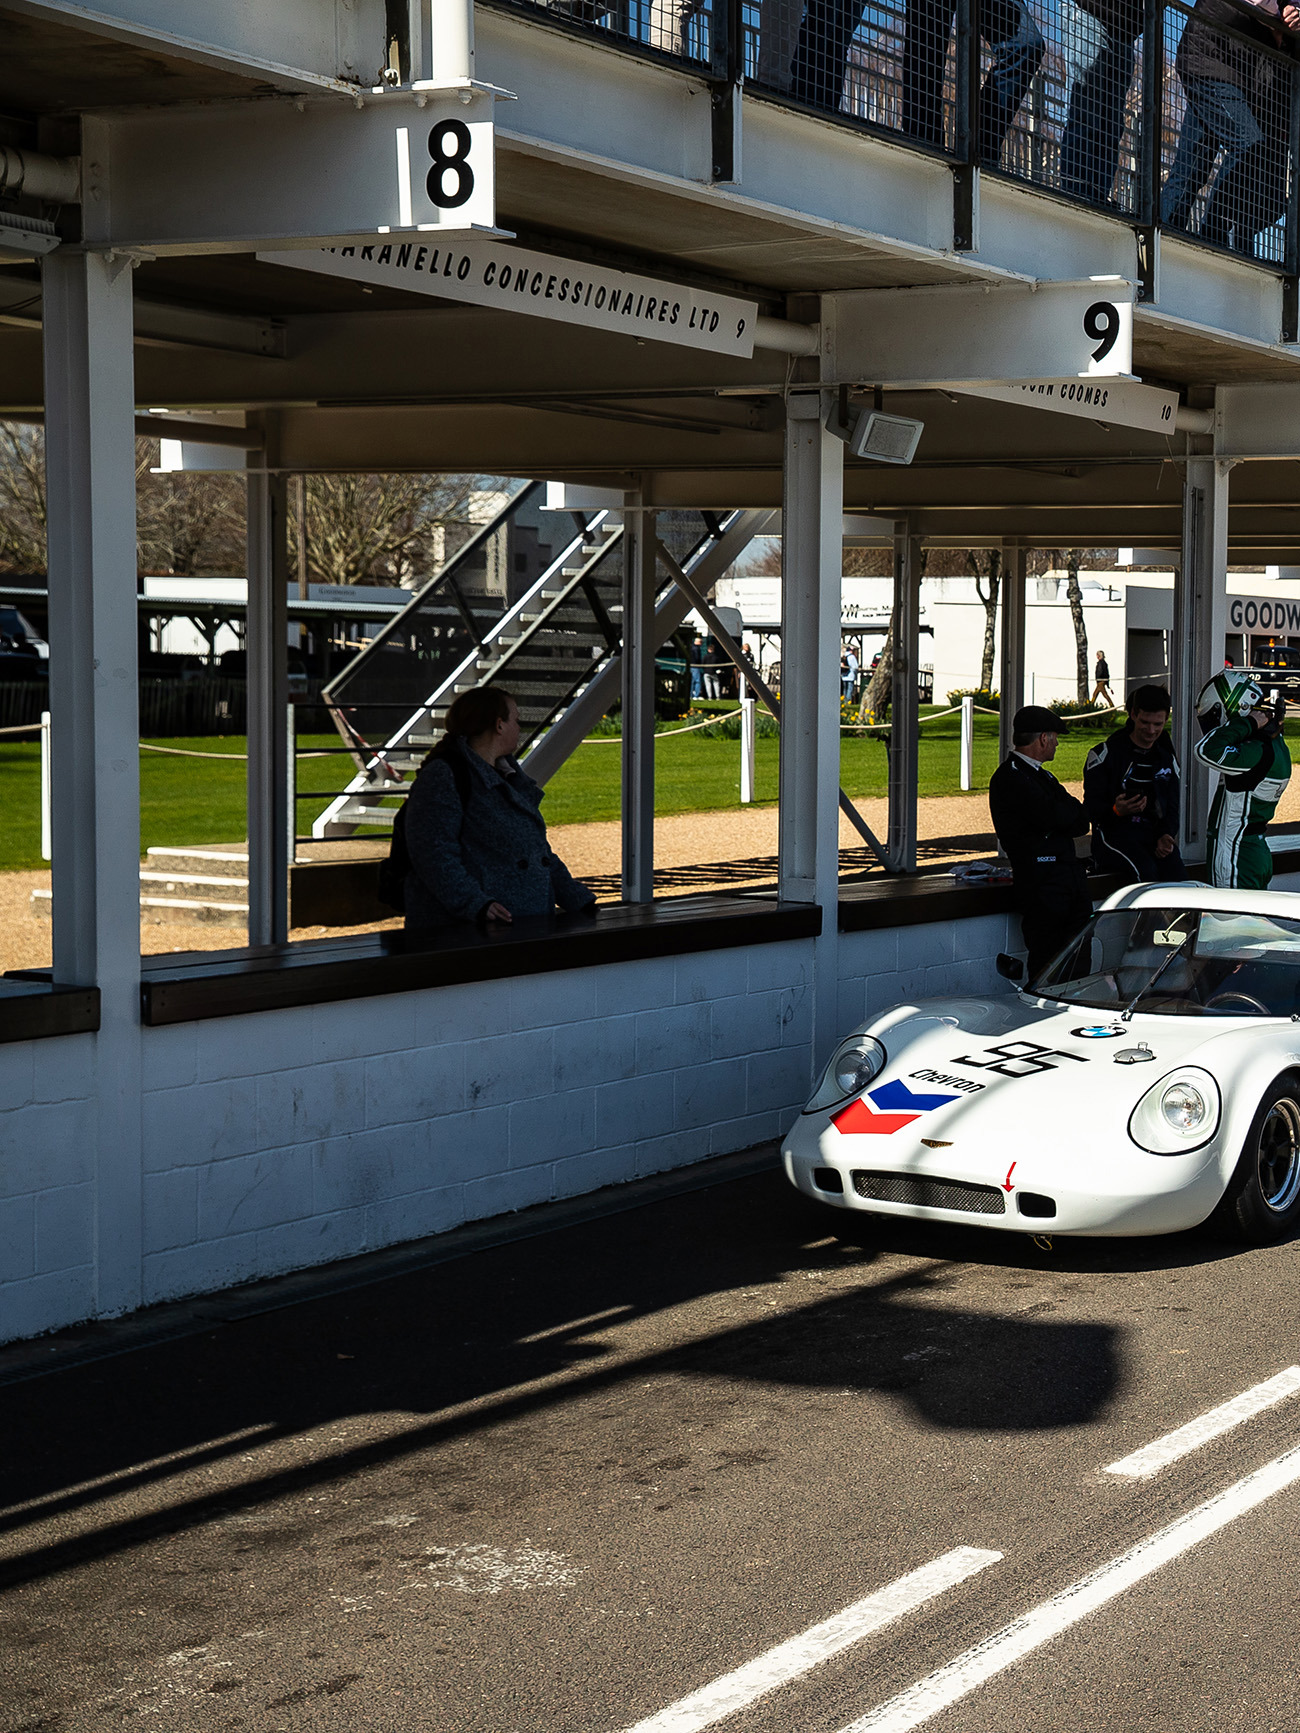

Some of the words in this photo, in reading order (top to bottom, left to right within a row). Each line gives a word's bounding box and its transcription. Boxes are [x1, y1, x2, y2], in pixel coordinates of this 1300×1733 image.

[426, 119, 475, 209] 8
[321, 244, 471, 281] RANELLO
[483, 261, 681, 325] CONCESSIONAIRES
[688, 306, 720, 333] LTD
[735, 318, 746, 339] 9
[1082, 301, 1120, 363] 9
[1060, 383, 1109, 407] COOMBS
[1160, 404, 1173, 421] 10
[950, 1040, 1091, 1078] 95
[908, 1068, 986, 1093] Chevron
